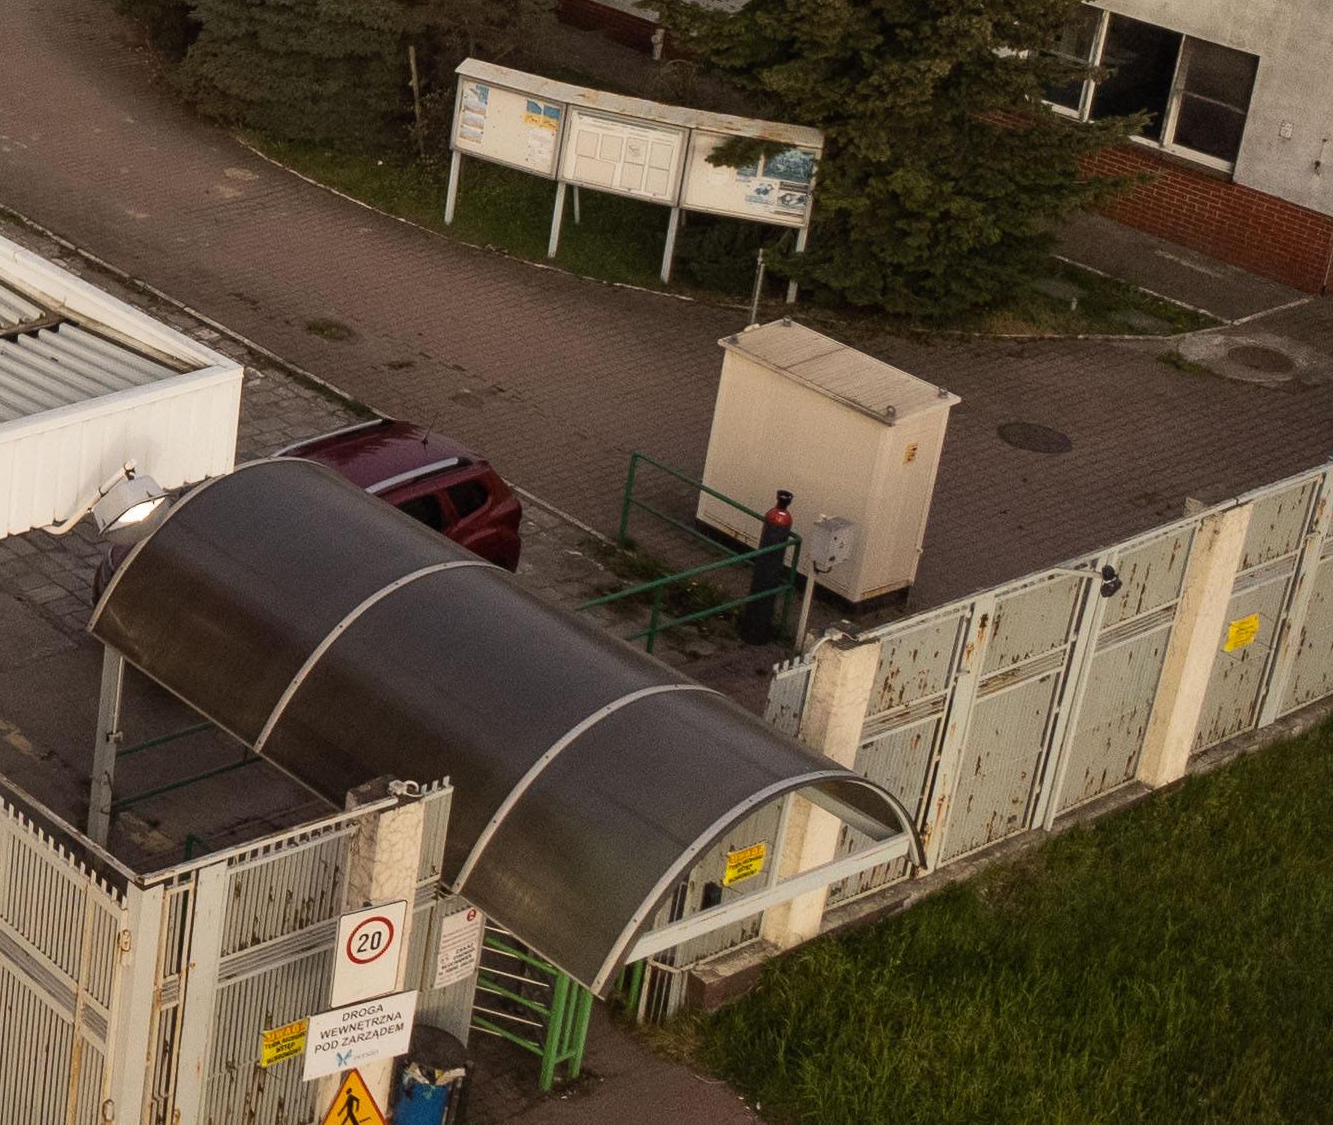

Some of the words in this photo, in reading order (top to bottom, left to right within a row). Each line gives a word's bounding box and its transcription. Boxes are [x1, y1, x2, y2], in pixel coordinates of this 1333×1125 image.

[357, 931, 381, 953] 20
[320, 1011, 402, 1039] WEWNĘTRZNA
[342, 1004, 383, 1022] DROGA
[315, 1040, 339, 1054] POD
[341, 1022, 405, 1047] ZARZĄDEM
